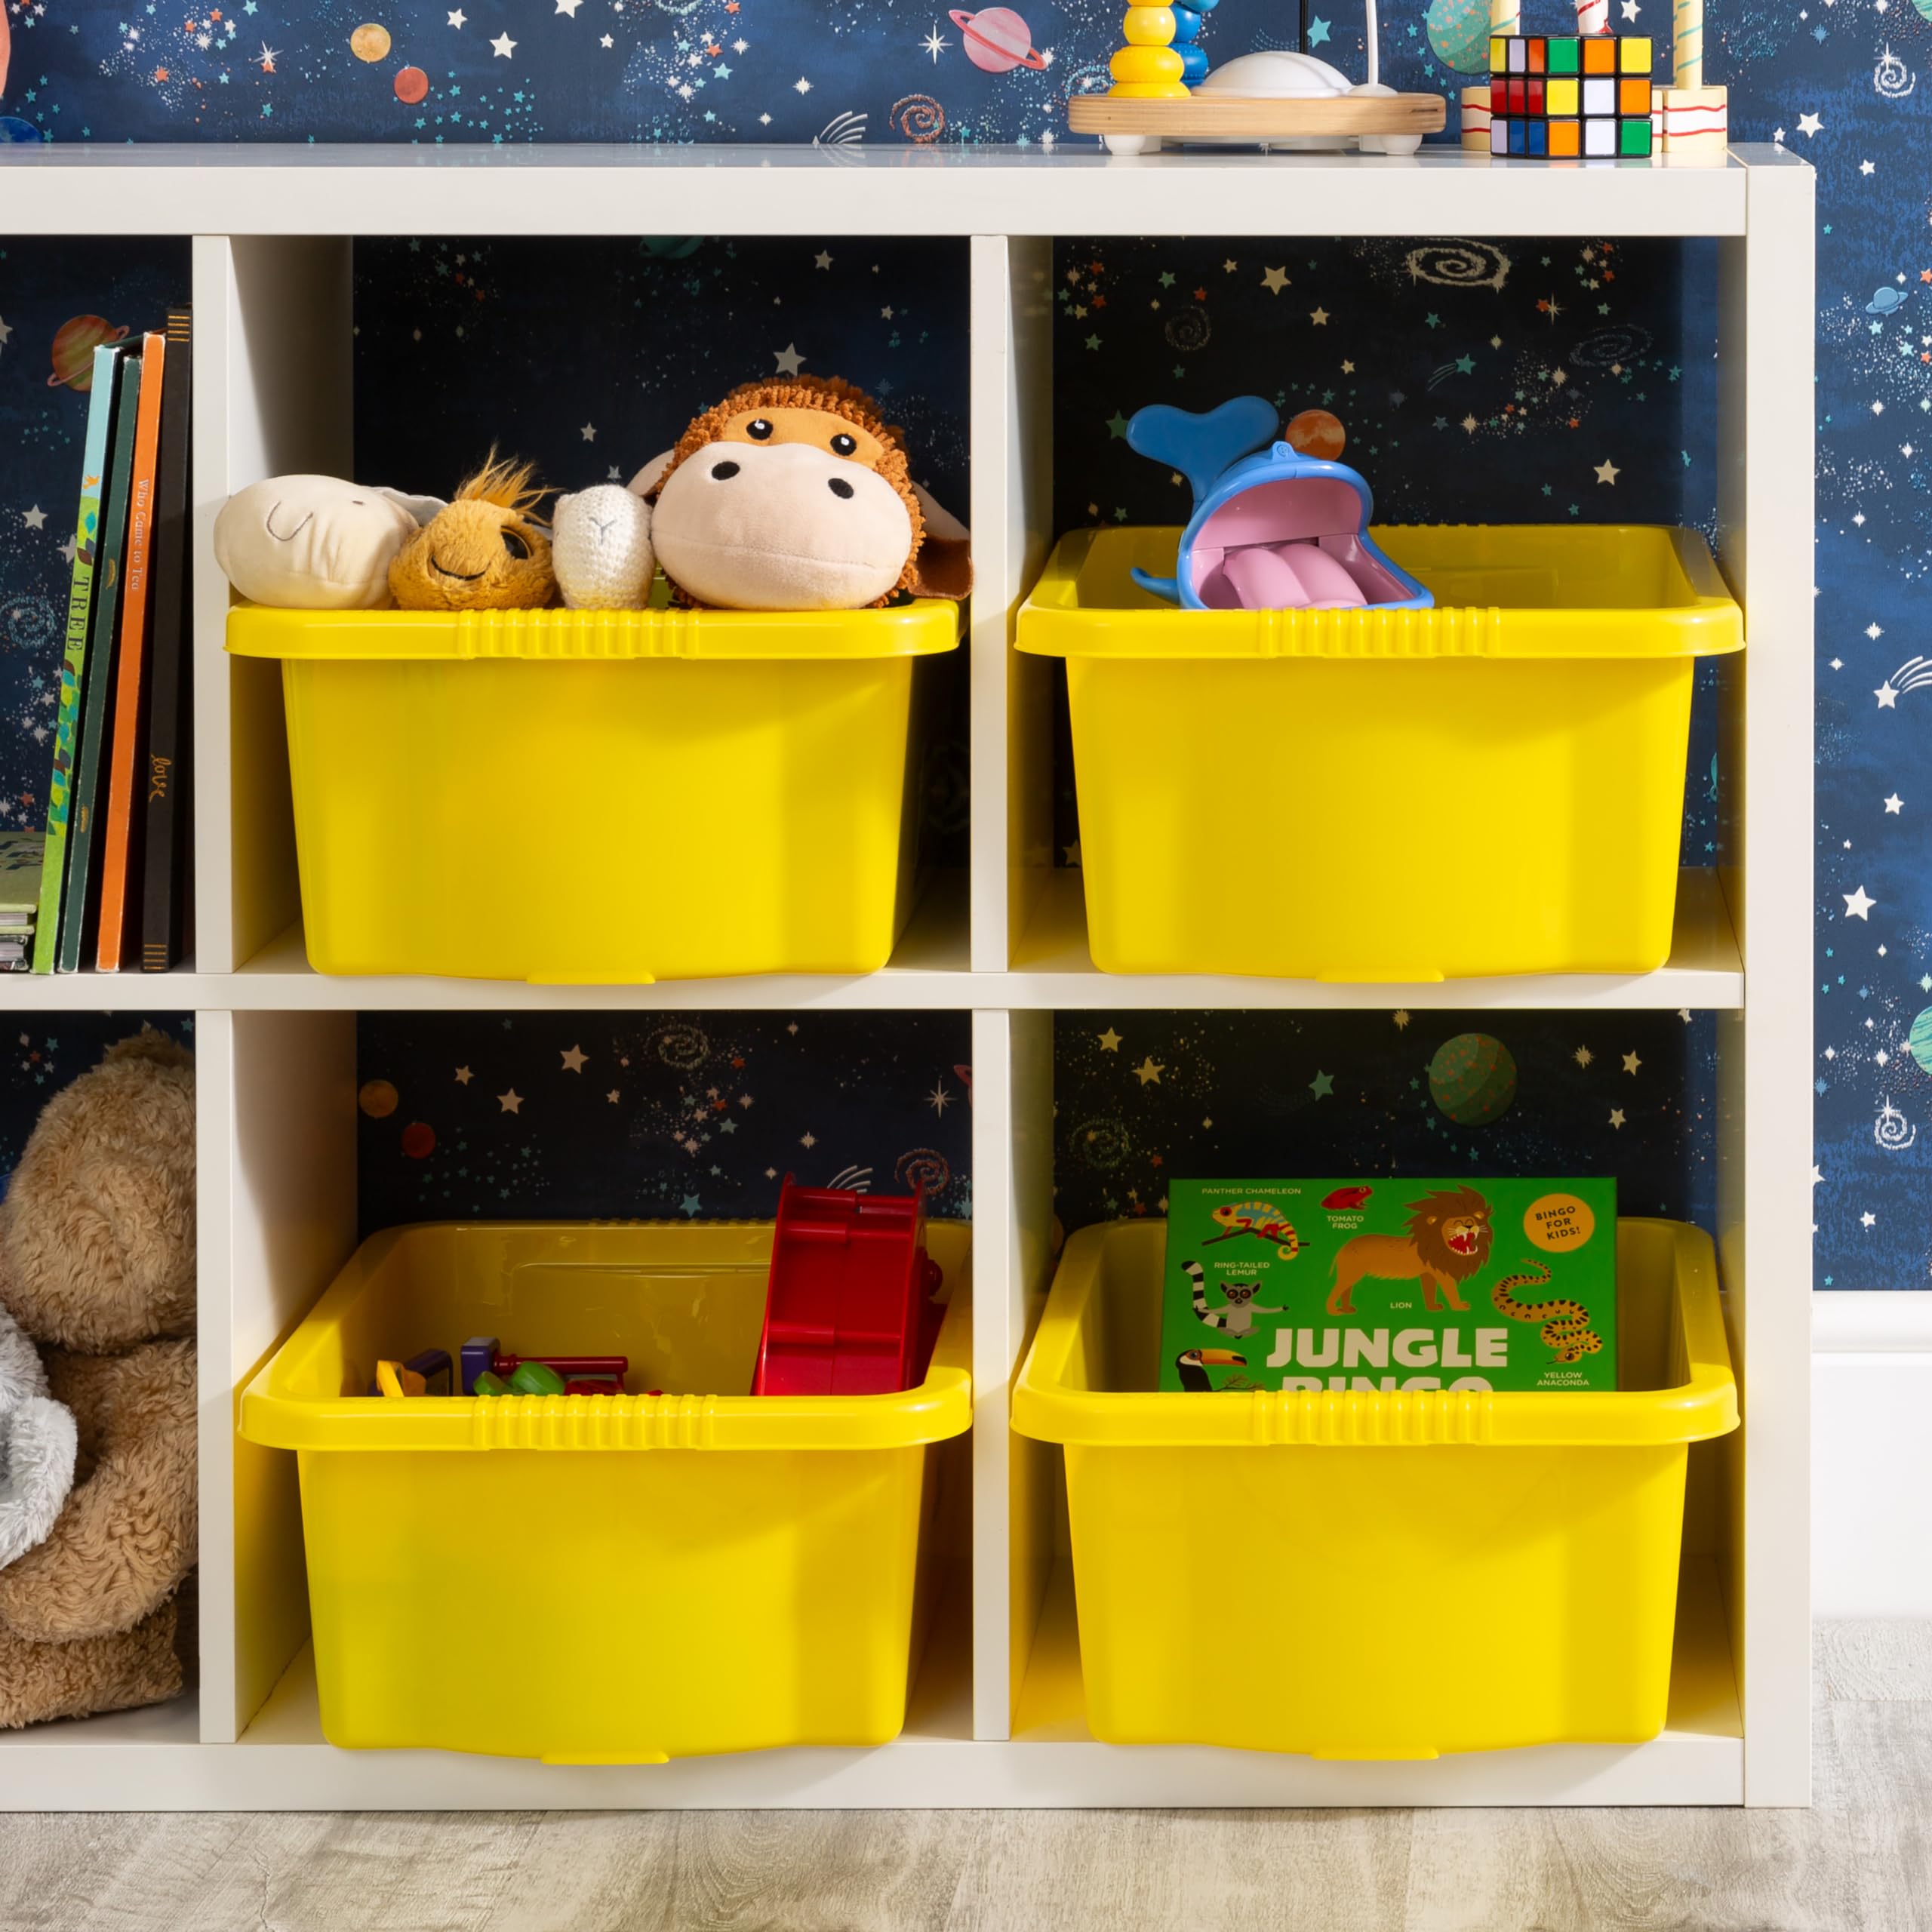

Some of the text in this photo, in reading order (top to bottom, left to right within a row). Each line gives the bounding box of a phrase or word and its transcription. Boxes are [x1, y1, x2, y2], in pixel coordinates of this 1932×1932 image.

[131, 478, 149, 590] Who Came to Tea
[67, 577, 90, 651] TREE
[149, 753, 172, 803] love
[1535, 1205, 1576, 1221] BINGO
[1546, 1217, 1571, 1229] FOR
[1546, 1226, 1581, 1240] KIDS!
[1266, 1328, 1508, 1367] JUNGLE
